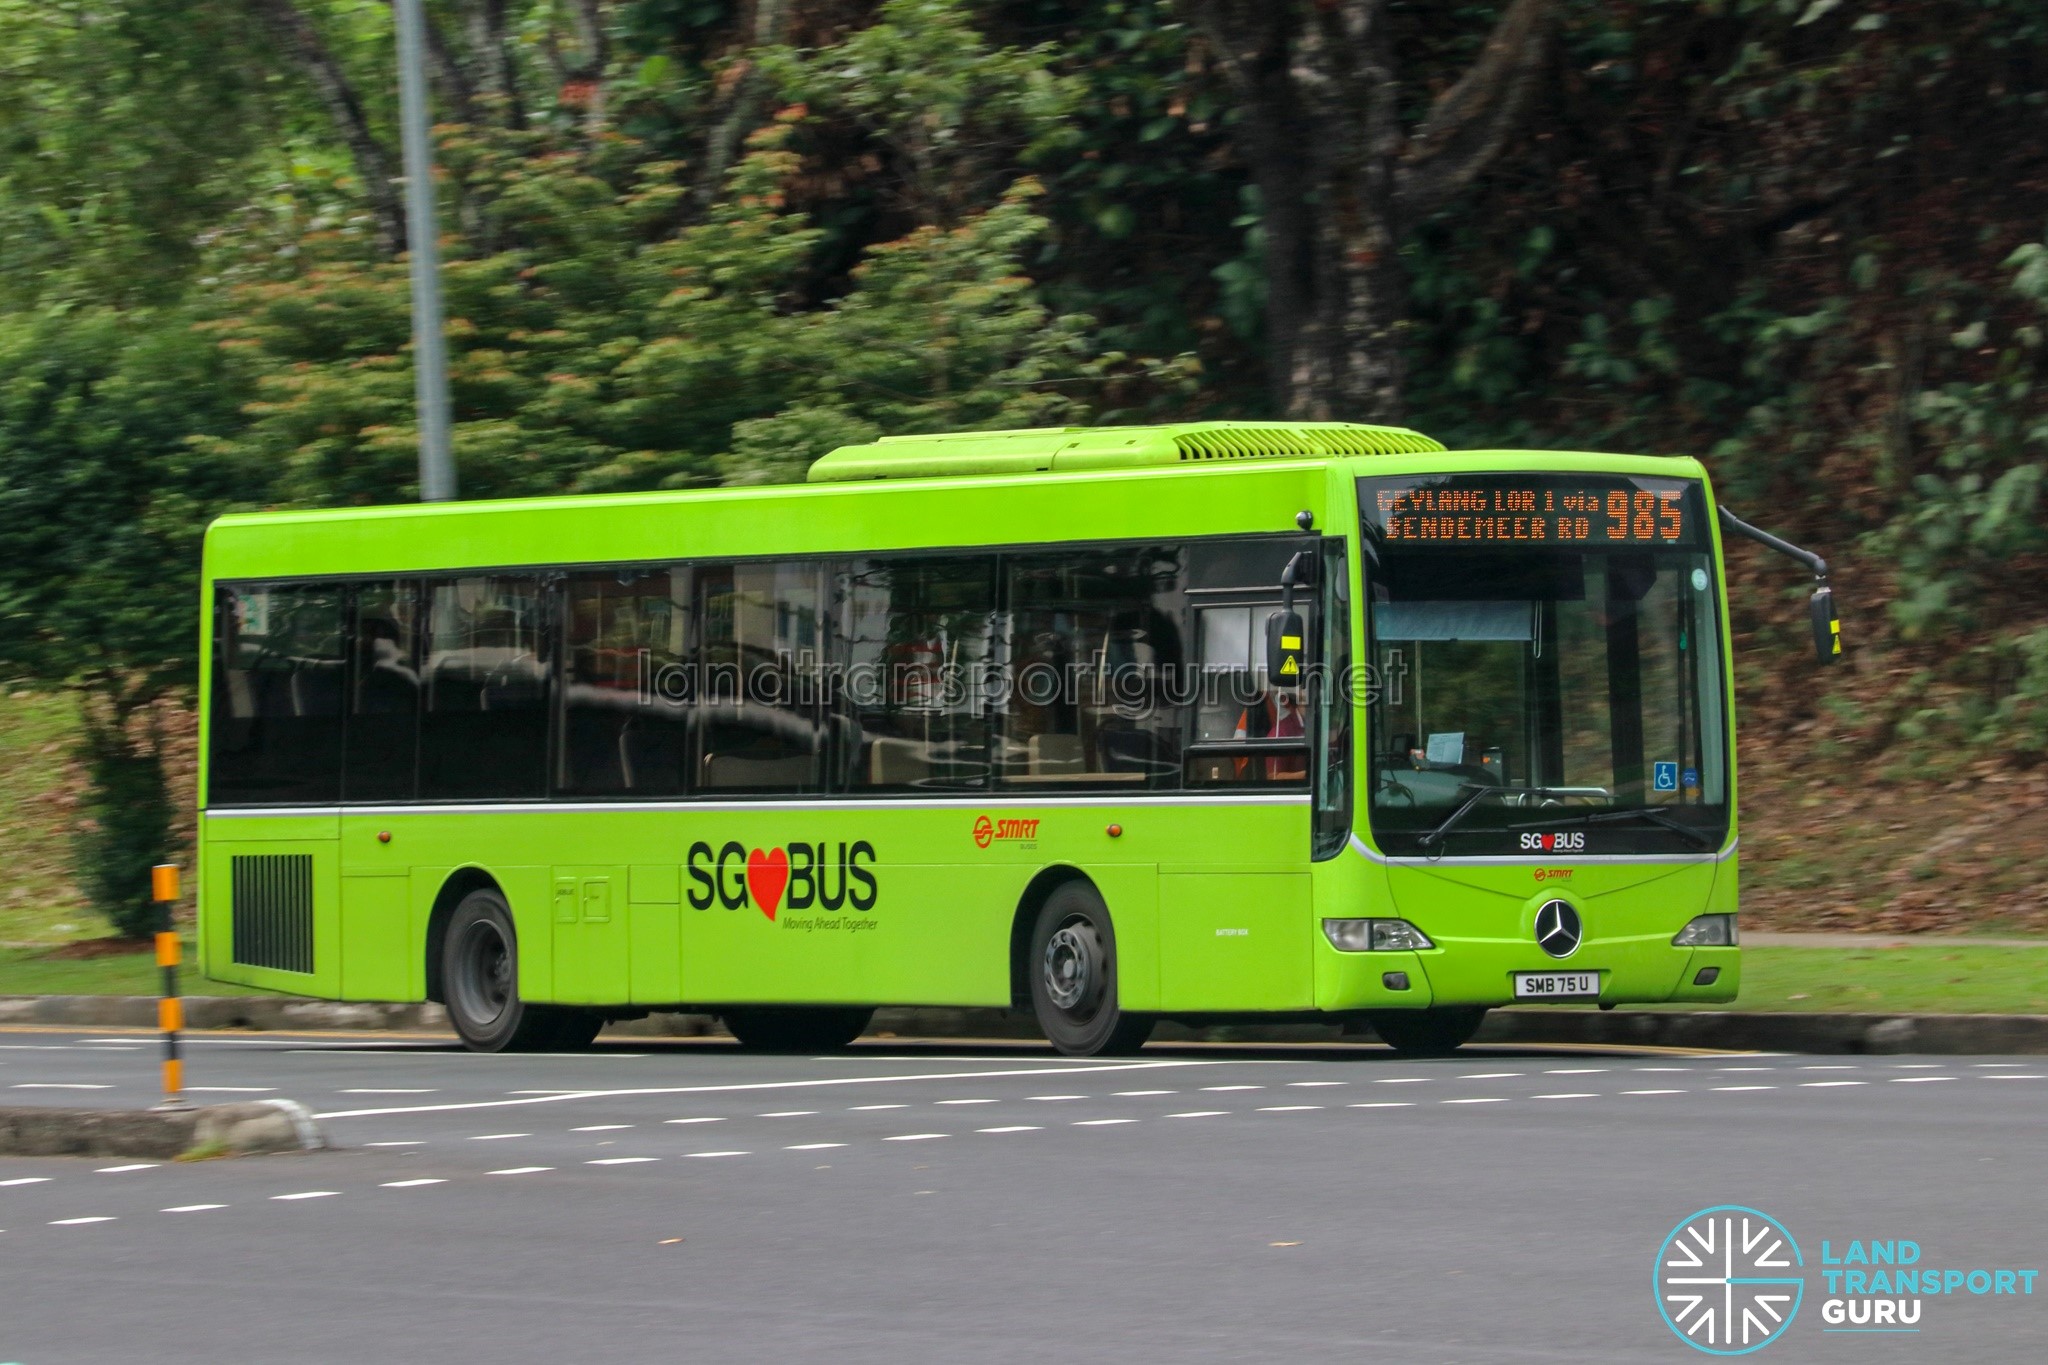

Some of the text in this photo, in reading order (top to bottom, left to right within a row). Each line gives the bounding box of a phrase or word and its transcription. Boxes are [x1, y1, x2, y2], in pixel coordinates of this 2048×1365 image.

[1376, 490, 1600, 511] GEYLANG LOR 1 via
[1606, 489, 1681, 539] 985
[1386, 517, 1589, 539] BENDEMEER RD
[995, 819, 1040, 839] SMRT
[1547, 869, 1573, 878] SMRT
[782, 916, 878, 933] Moving Ahead Together
[1525, 976, 1588, 993] SMB 75 U
